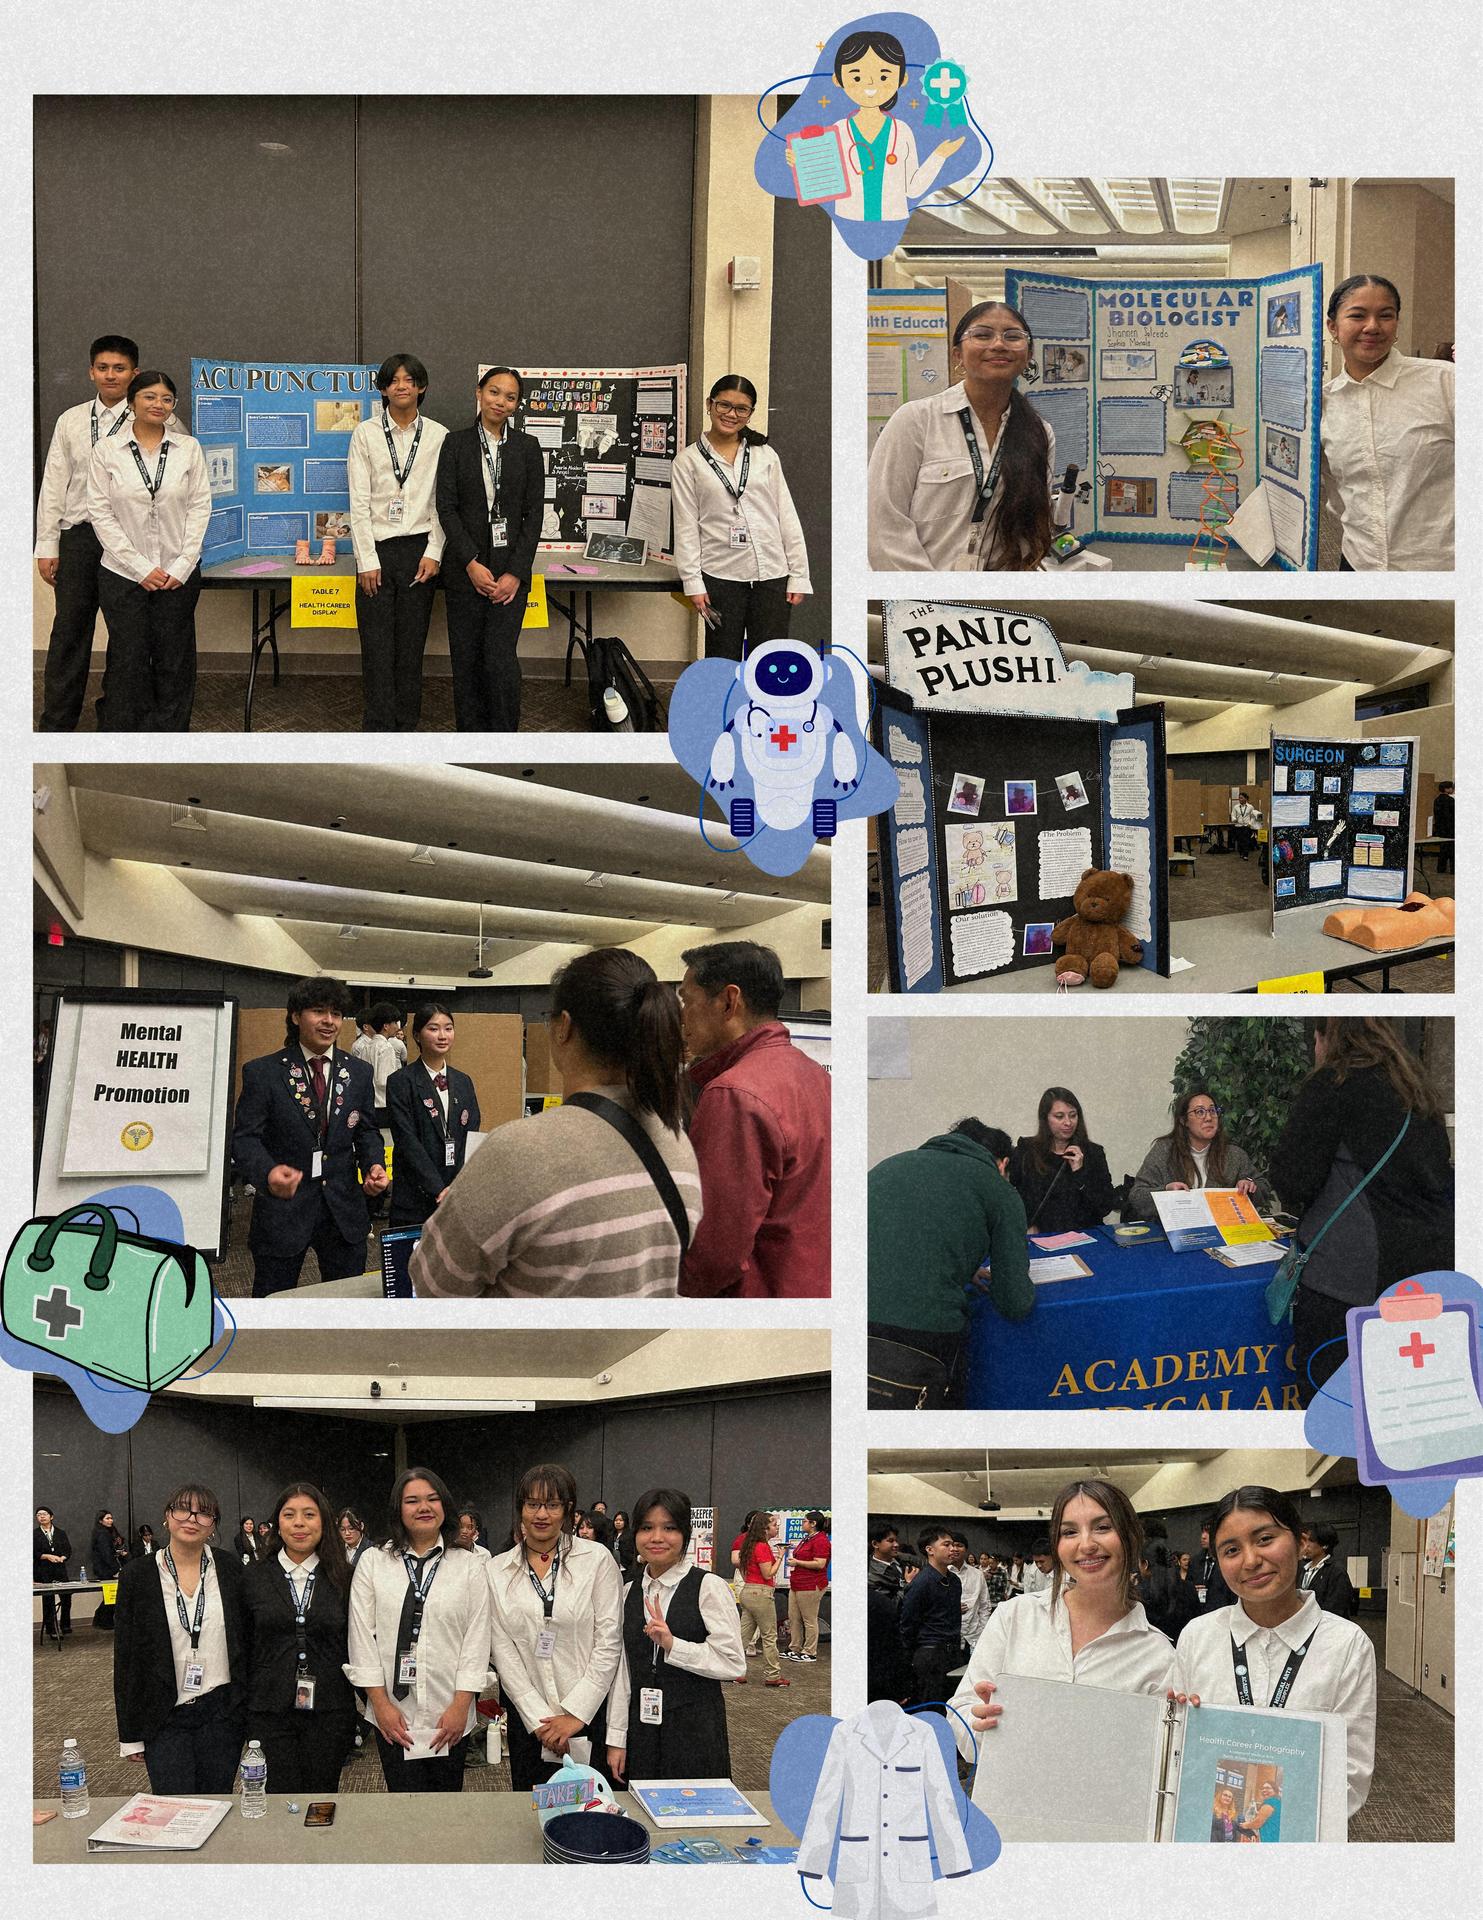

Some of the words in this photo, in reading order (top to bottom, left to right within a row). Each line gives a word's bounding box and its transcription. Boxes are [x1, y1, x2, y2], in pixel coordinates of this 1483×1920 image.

[1098, 291, 1254, 308] MOLECULAR
[1109, 310, 1240, 326] BIOLOGIST
[195, 366, 382, 393] ACUPUNCTUR
[910, 604, 934, 620] THE
[903, 616, 1032, 658] PANIC
[1275, 746, 1345, 763] SURGEON
[971, 912, 999, 920] solution
[120, 1023, 182, 1041] Mental
[116, 1050, 178, 1069] HEALTH
[94, 1084, 190, 1104] Promotion
[1048, 1344, 1278, 1397] ACADEMY
[1253, 1384, 1303, 1410] AR
[691, 1509, 713, 1519] KEEPER
[692, 1520, 712, 1528] HUMB
[1273, 1680, 1286, 1704] MEDICAL
[1282, 1667, 1292, 1680] ARTS
[1199, 1736, 1225, 1745] Health
[1227, 1739, 1253, 1749] Career
[1254, 1742, 1306, 1758] Photography
[533, 1783, 576, 1807] TAKE
